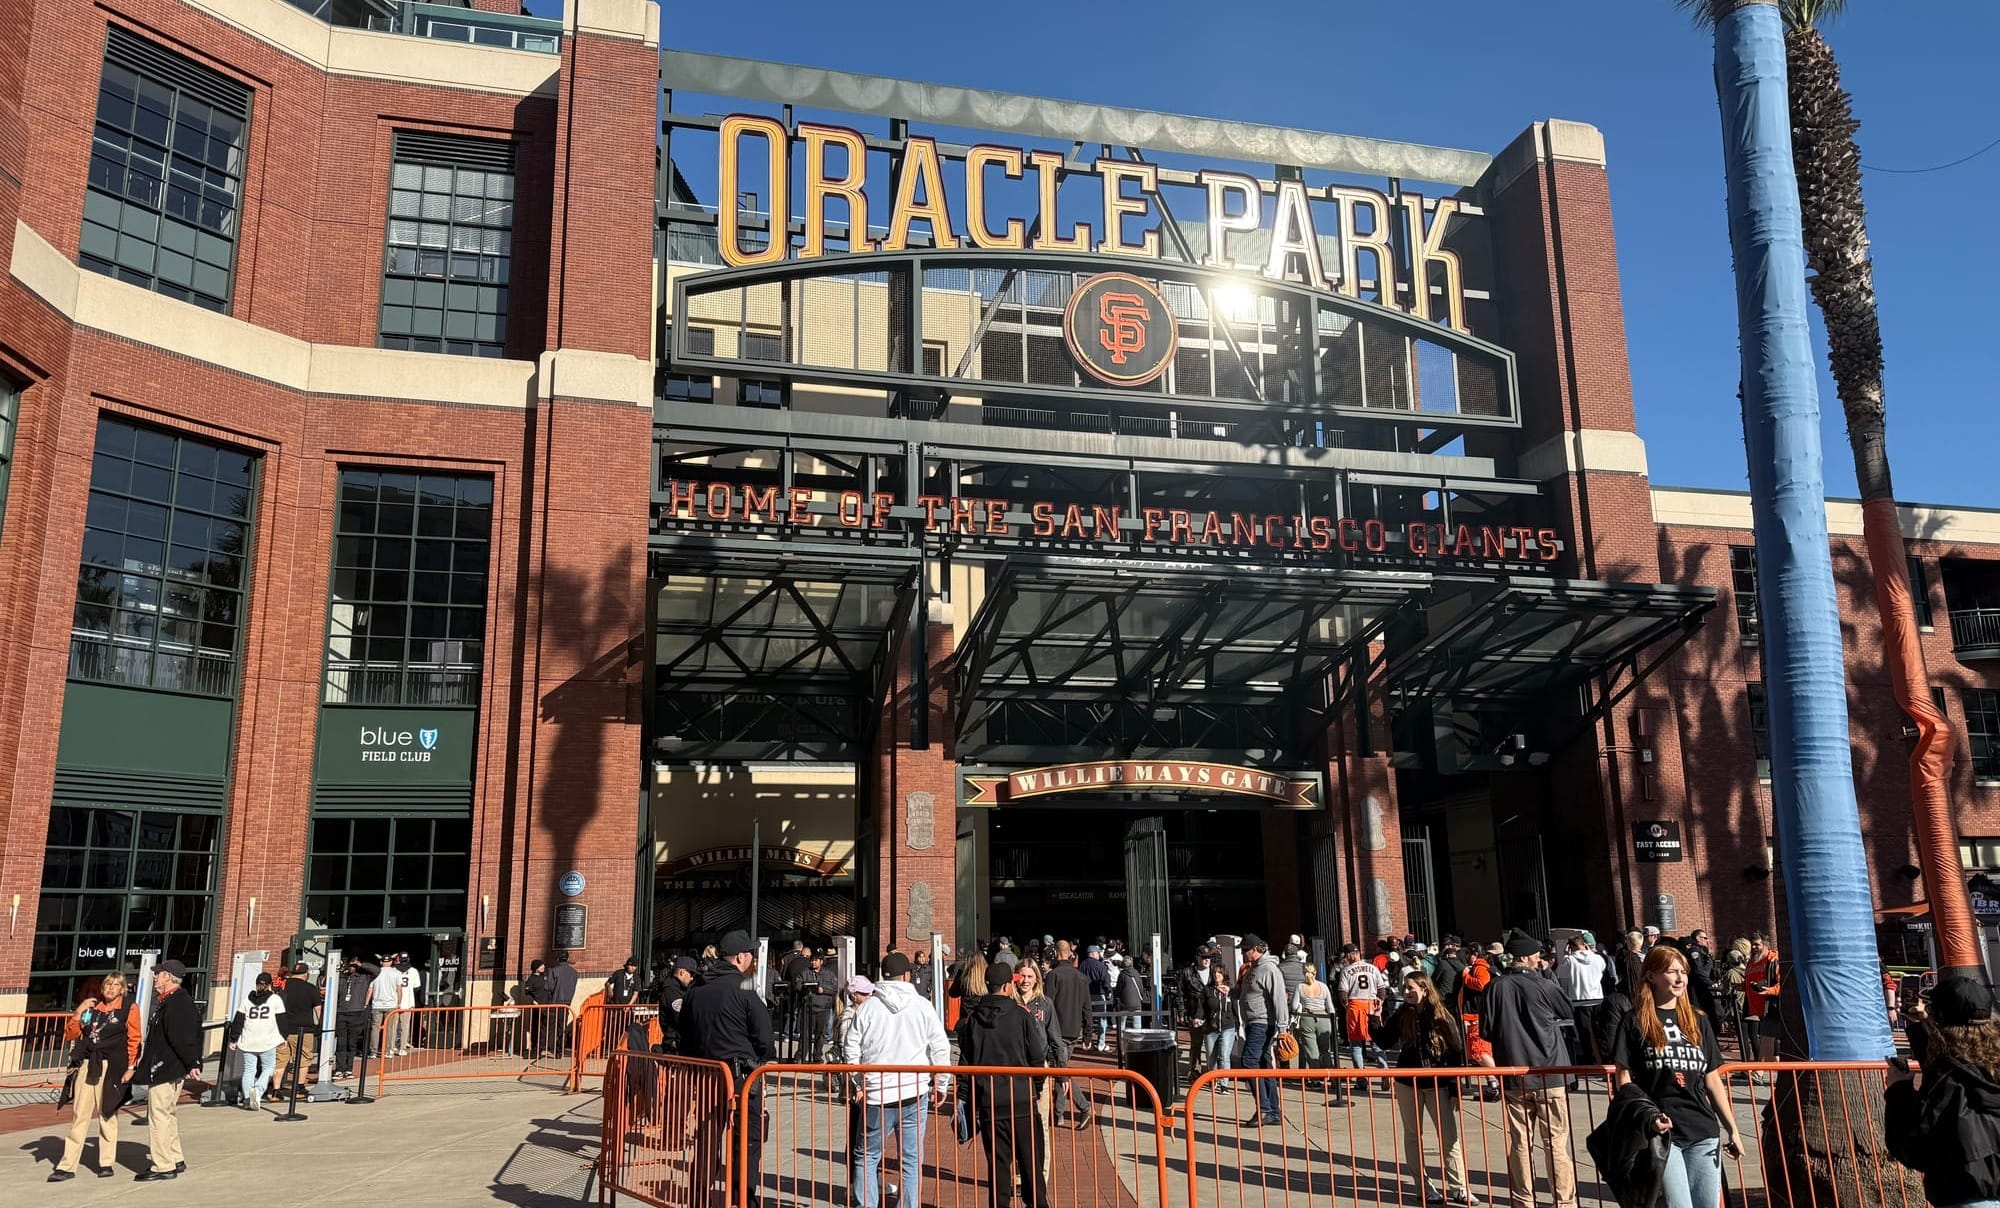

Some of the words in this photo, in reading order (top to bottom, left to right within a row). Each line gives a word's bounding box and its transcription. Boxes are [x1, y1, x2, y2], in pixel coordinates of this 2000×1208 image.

[718, 113, 1160, 267] ORACLE
[1200, 169, 1473, 336] PARK
[668, 479, 814, 524] HOME
[838, 491, 896, 528] OF
[918, 494, 1010, 535] THE
[1031, 501, 1120, 541] SAN
[1142, 506, 1386, 552] FRANCISCO
[1408, 522, 1560, 560] GIANTS
[360, 726, 413, 746] blue
[362, 751, 396, 762] FIELD
[400, 751, 431, 762] CLUB
[1016, 765, 1123, 793] WILLIE
[1135, 765, 1211, 785] MAYS
[1220, 770, 1287, 796] GATE
[1636, 841, 1653, 849] FAST
[766, 849, 813, 865] MAYS
[664, 881, 694, 889] THE
[702, 880, 733, 889] SAY
[771, 879, 800, 888] HEY
[809, 878, 834, 887] KID
[78, 947, 104, 957] blue
[1358, 974, 1369, 989] 8
[249, 1006, 270, 1019] 62
